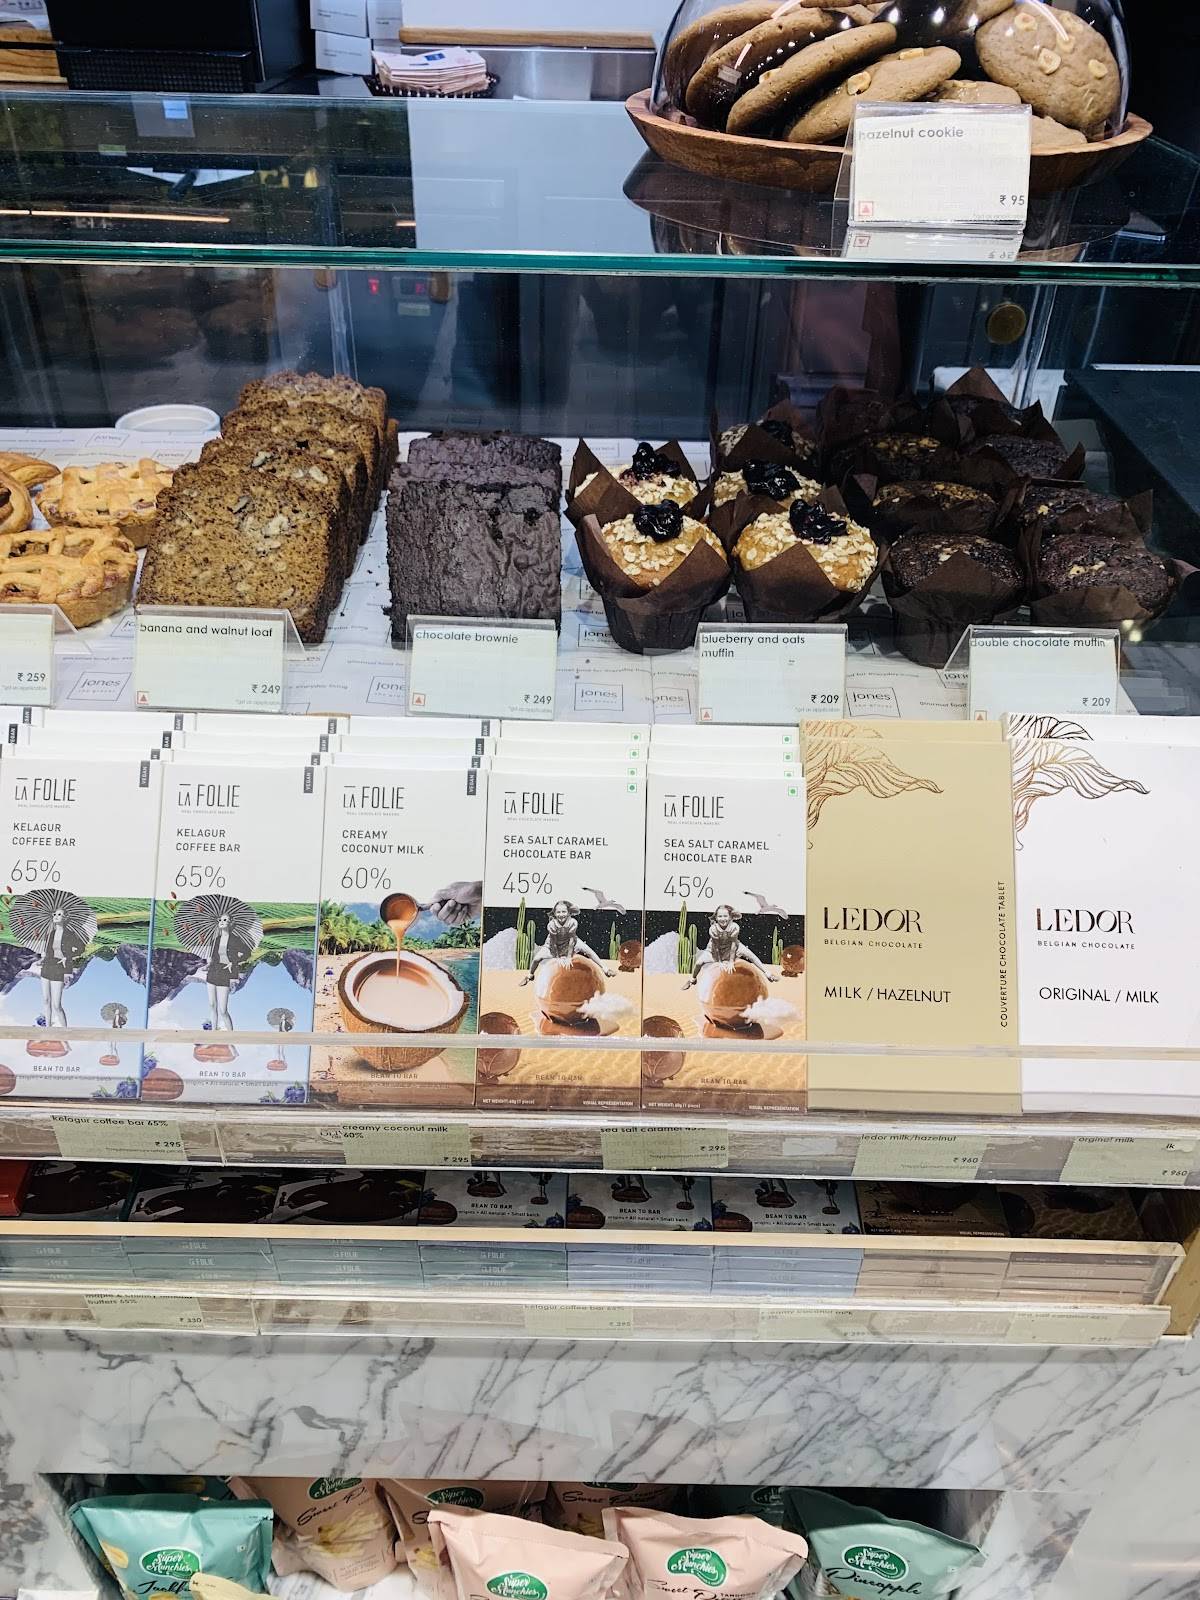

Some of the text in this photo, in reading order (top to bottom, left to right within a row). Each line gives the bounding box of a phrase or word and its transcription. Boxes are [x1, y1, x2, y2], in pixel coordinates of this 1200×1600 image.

[858, 126, 964, 140] hazelnut cookie
[999, 194, 1024, 206] ₹ 95
[140, 623, 182, 634] banana
[186, 624, 208, 634] and
[212, 626, 248, 636] walnut
[251, 627, 273, 637] loaf
[416, 630, 518, 644] chocolate brownie
[701, 634, 806, 646] blueberry and oats
[970, 637, 1106, 648] double chocolate muffin
[701, 648, 734, 658] muffin
[17, 672, 46, 682] ₹ 259
[81, 678, 120, 688] jones
[252, 684, 281, 694] ₹ 249
[580, 688, 618, 698] jones
[524, 694, 552, 705] ₹ 249
[810, 694, 840, 704] ₹ 209
[852, 691, 891, 702] jones
[1082, 697, 1111, 707] ₹ 209
[141, 765, 149, 786] VEGAN
[304, 772, 313, 792] VEGAN
[14, 778, 76, 802] LA FOLIE
[178, 784, 240, 808] LA FOLIE
[343, 785, 405, 809] LA FOLIE
[504, 791, 564, 815] LA FOLIE
[664, 794, 725, 818] LA FOLIE
[13, 822, 62, 832] KELAGUR
[176, 828, 226, 838] KELAGUR
[12, 836, 76, 847] COFFEE BAR
[342, 830, 388, 840] CREAMY
[503, 835, 608, 846] SEA SALT CARAMEL
[176, 842, 240, 852] COFFEE BAR
[342, 844, 424, 855] COCONUT MILK
[664, 838, 770, 851] SEA SALT CARAMEL
[503, 849, 592, 860] CHOCOLATE BAR
[664, 853, 752, 864] CHOCOLATE BAR
[11, 859, 61, 882] 65%
[175, 865, 226, 888] 65%
[341, 867, 392, 889] 60%
[502, 872, 553, 894] 45%
[663, 876, 714, 898] 45%
[823, 906, 924, 934] LEDOR
[1036, 908, 1136, 934] LEDOR
[824, 938, 923, 949] BELGIAN CHOCOLATE
[998, 913, 1007, 967] CHOCOLATE
[1037, 940, 1135, 950] BELGIAN CHOCOLATE
[824, 986, 952, 1003] MILK / HAZELNUT
[1000, 969, 1008, 1028] COUVERTURE
[1039, 986, 1160, 1004] ORIGINAL / MILK
[384, 1124, 425, 1132] coconut
[890, 1134, 957, 1142] milk/hazelnut
[157, 1550, 184, 1564] Super
[686, 1550, 712, 1562] Super
[863, 1548, 890, 1560] Super
[147, 1556, 192, 1574] Munchies
[671, 1556, 718, 1574] Munchies
[848, 1552, 898, 1571] Munchies
[503, 1574, 530, 1588] Super
[825, 1568, 922, 1596] Pineapple
[491, 1582, 542, 1598] Munchies
